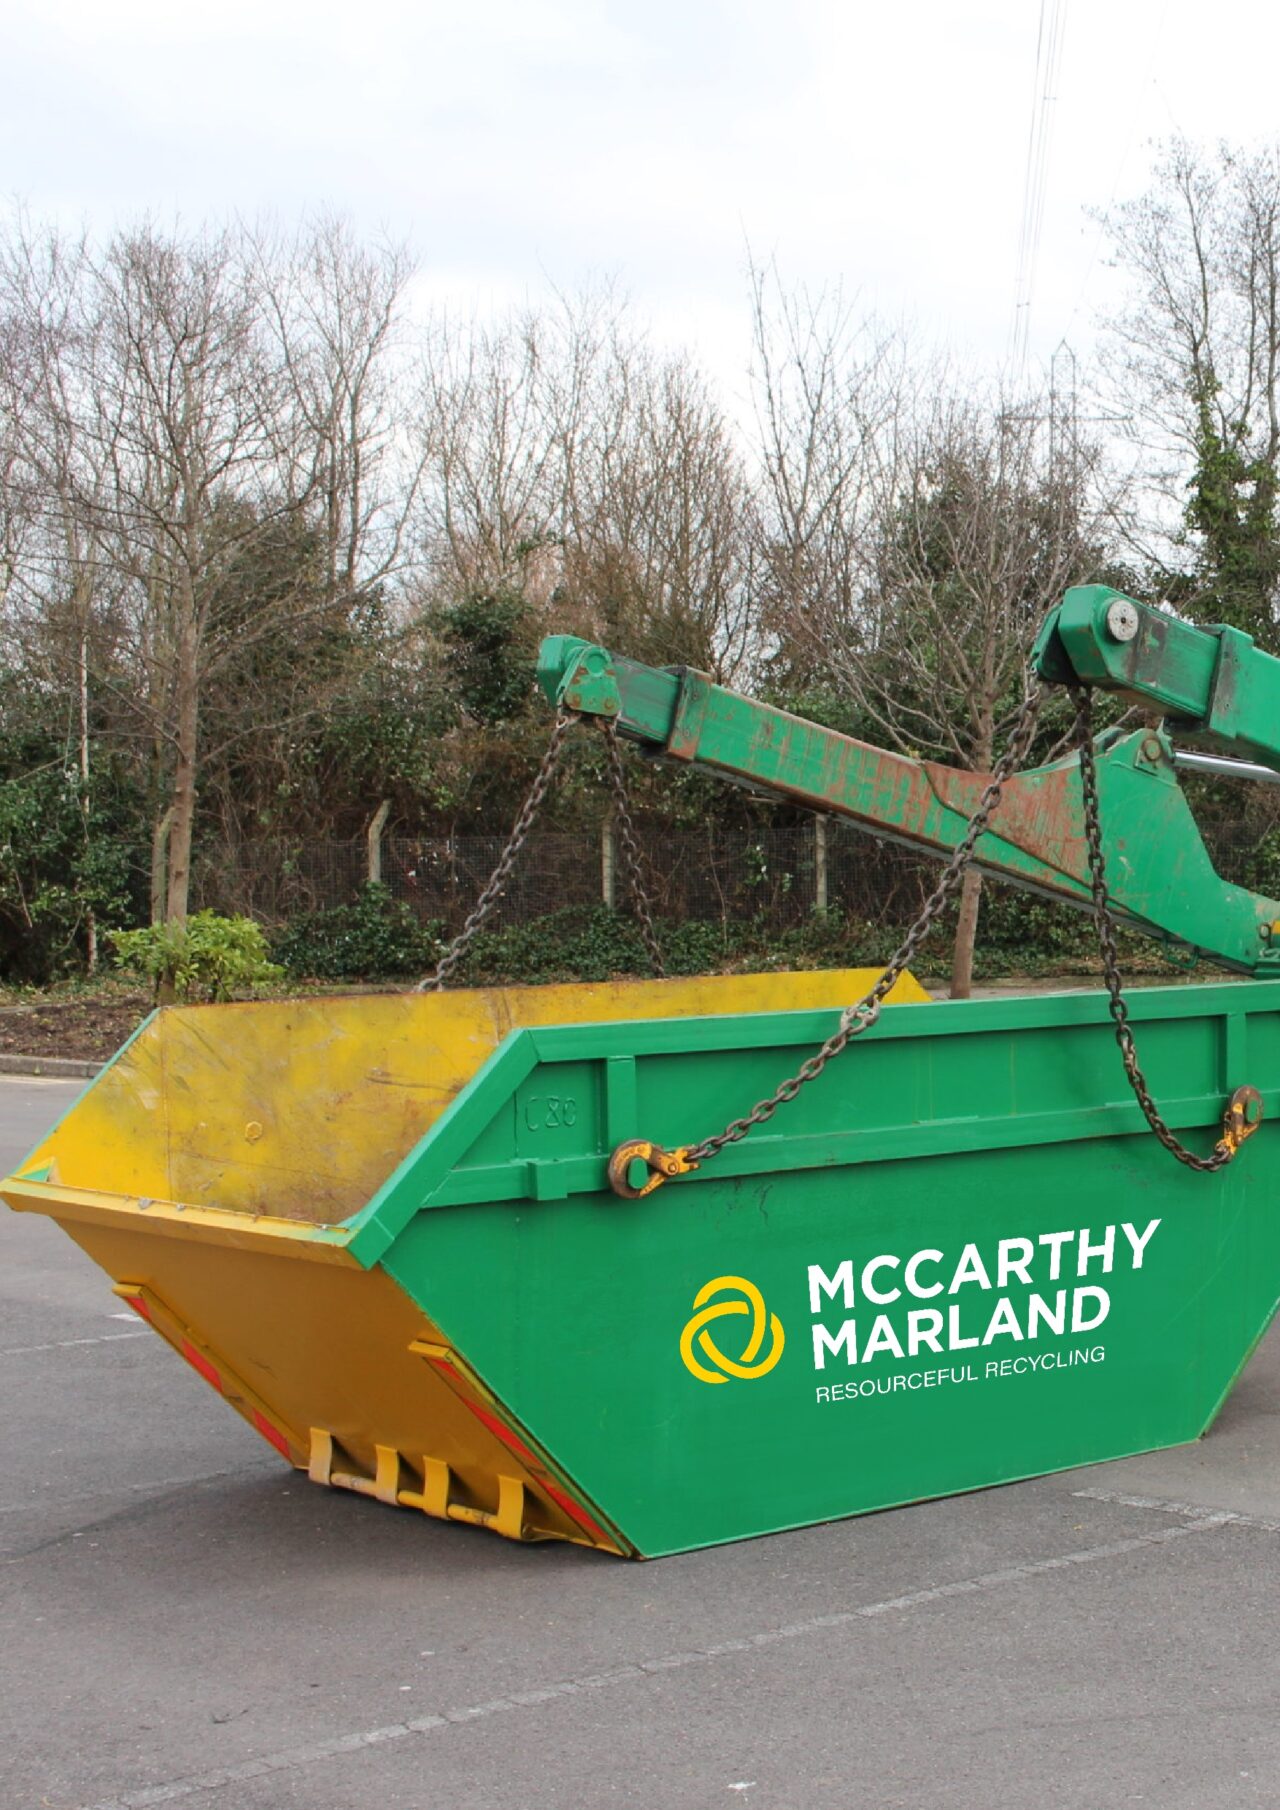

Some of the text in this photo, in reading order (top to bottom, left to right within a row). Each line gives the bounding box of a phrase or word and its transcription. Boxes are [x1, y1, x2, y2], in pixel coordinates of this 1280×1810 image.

[807, 1218, 1162, 1314] MCCARTHY
[811, 1285, 1111, 1370] MARLAND
[815, 1346, 1105, 1404] RESOURCEFUL RECYCLING
